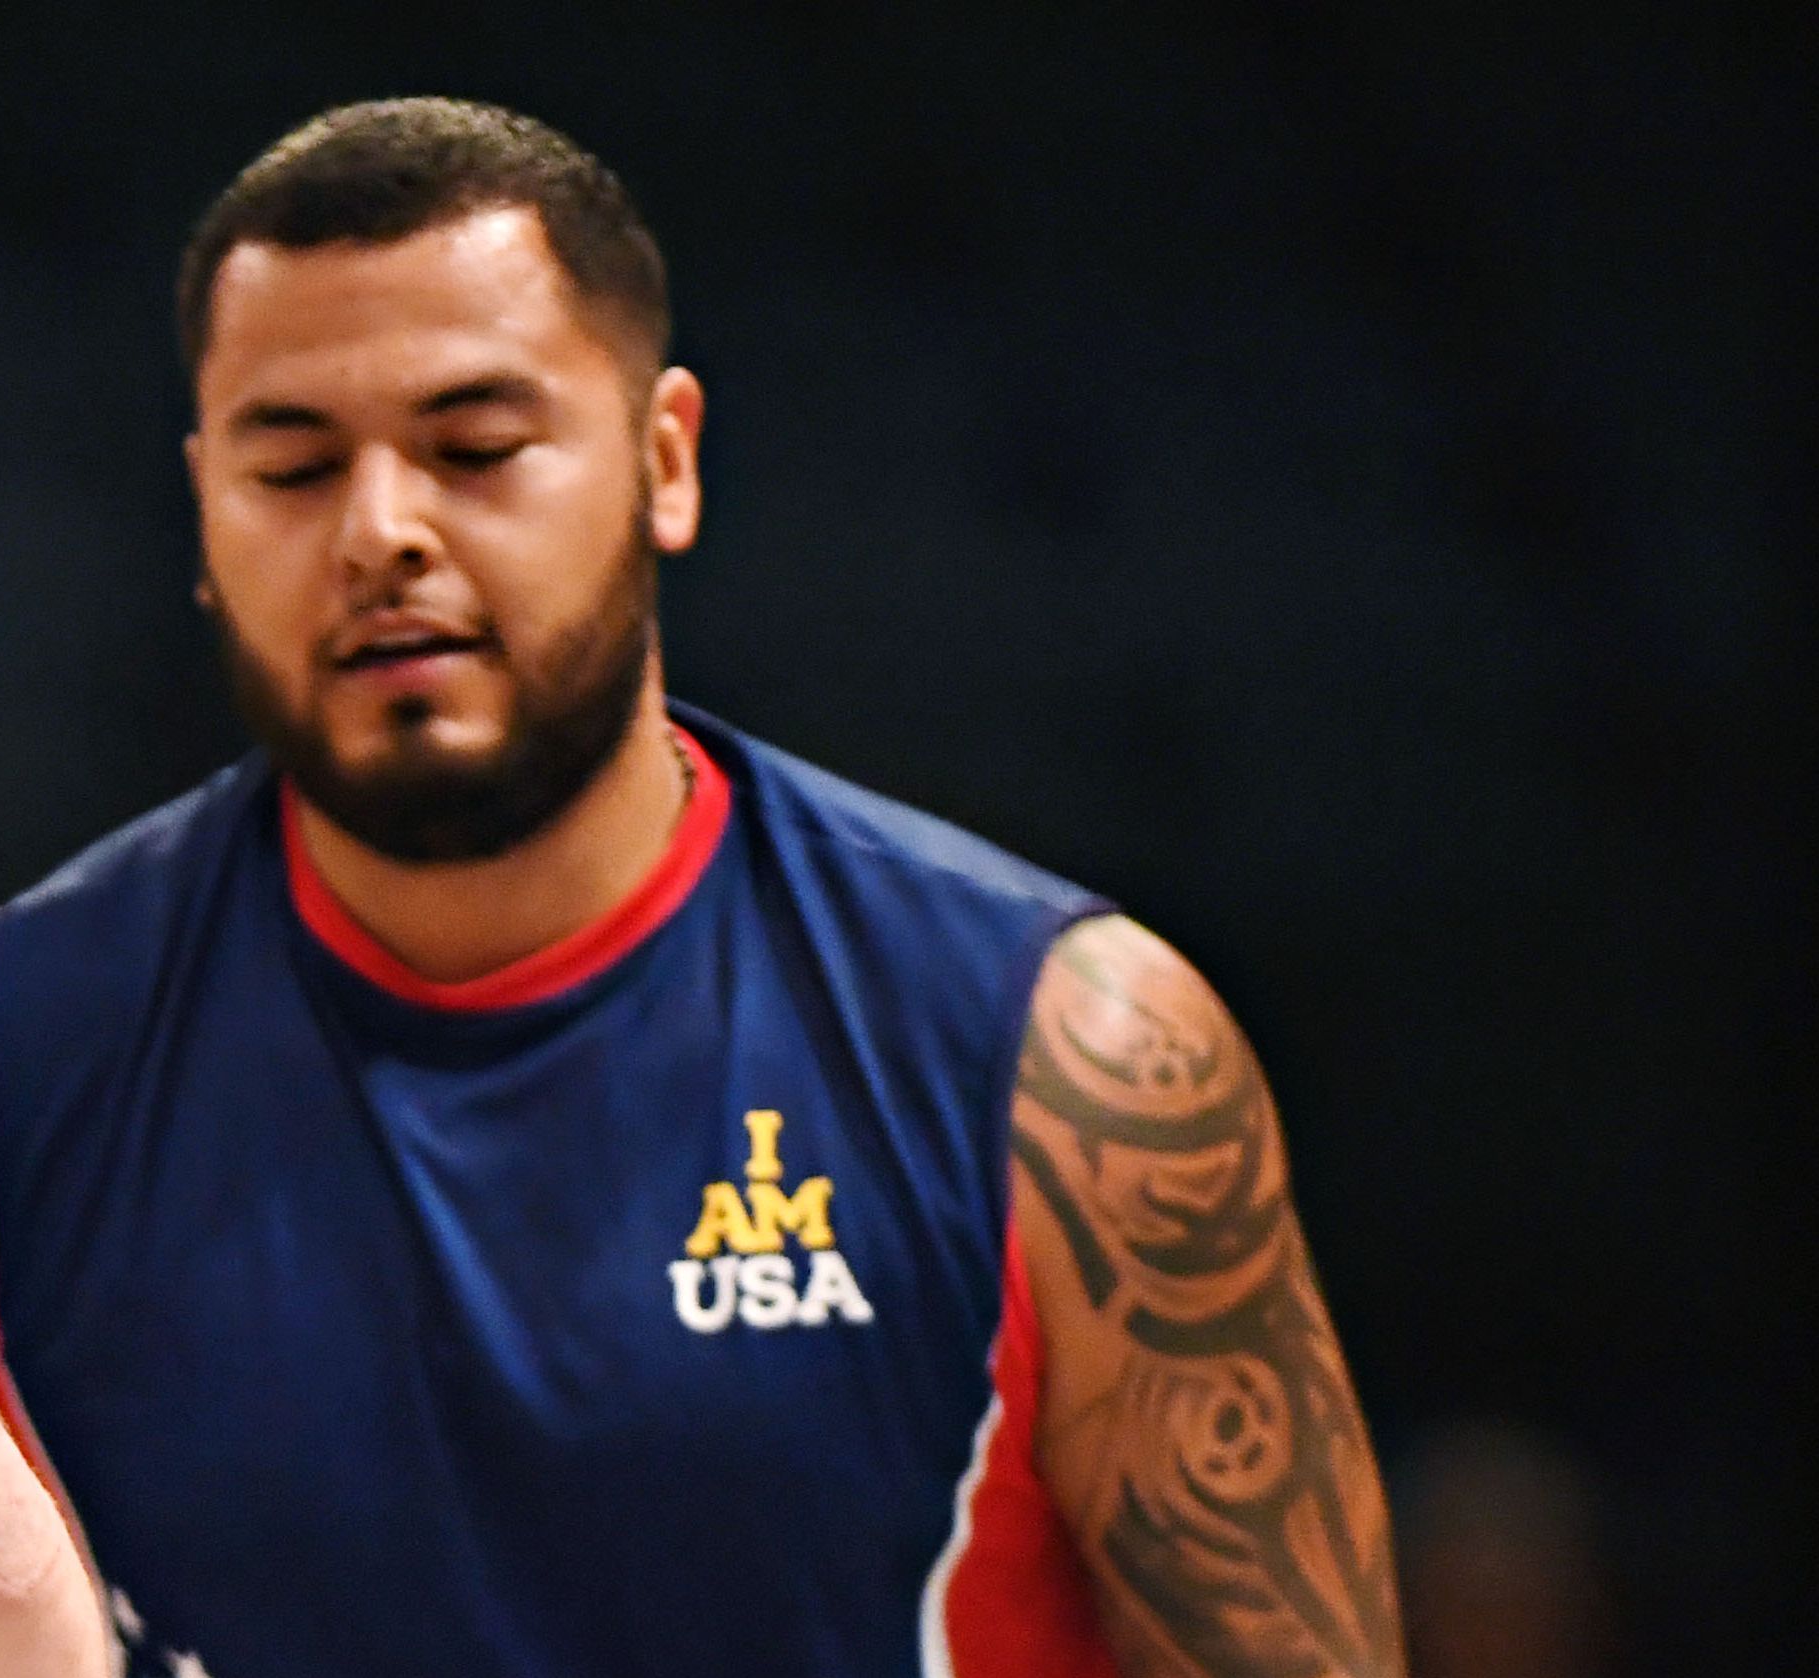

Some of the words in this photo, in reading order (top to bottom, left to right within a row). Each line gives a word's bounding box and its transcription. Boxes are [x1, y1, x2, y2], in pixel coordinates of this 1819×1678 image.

[742, 1108, 785, 1183] I
[685, 1174, 835, 1259] AM
[667, 1250, 875, 1334] USA
